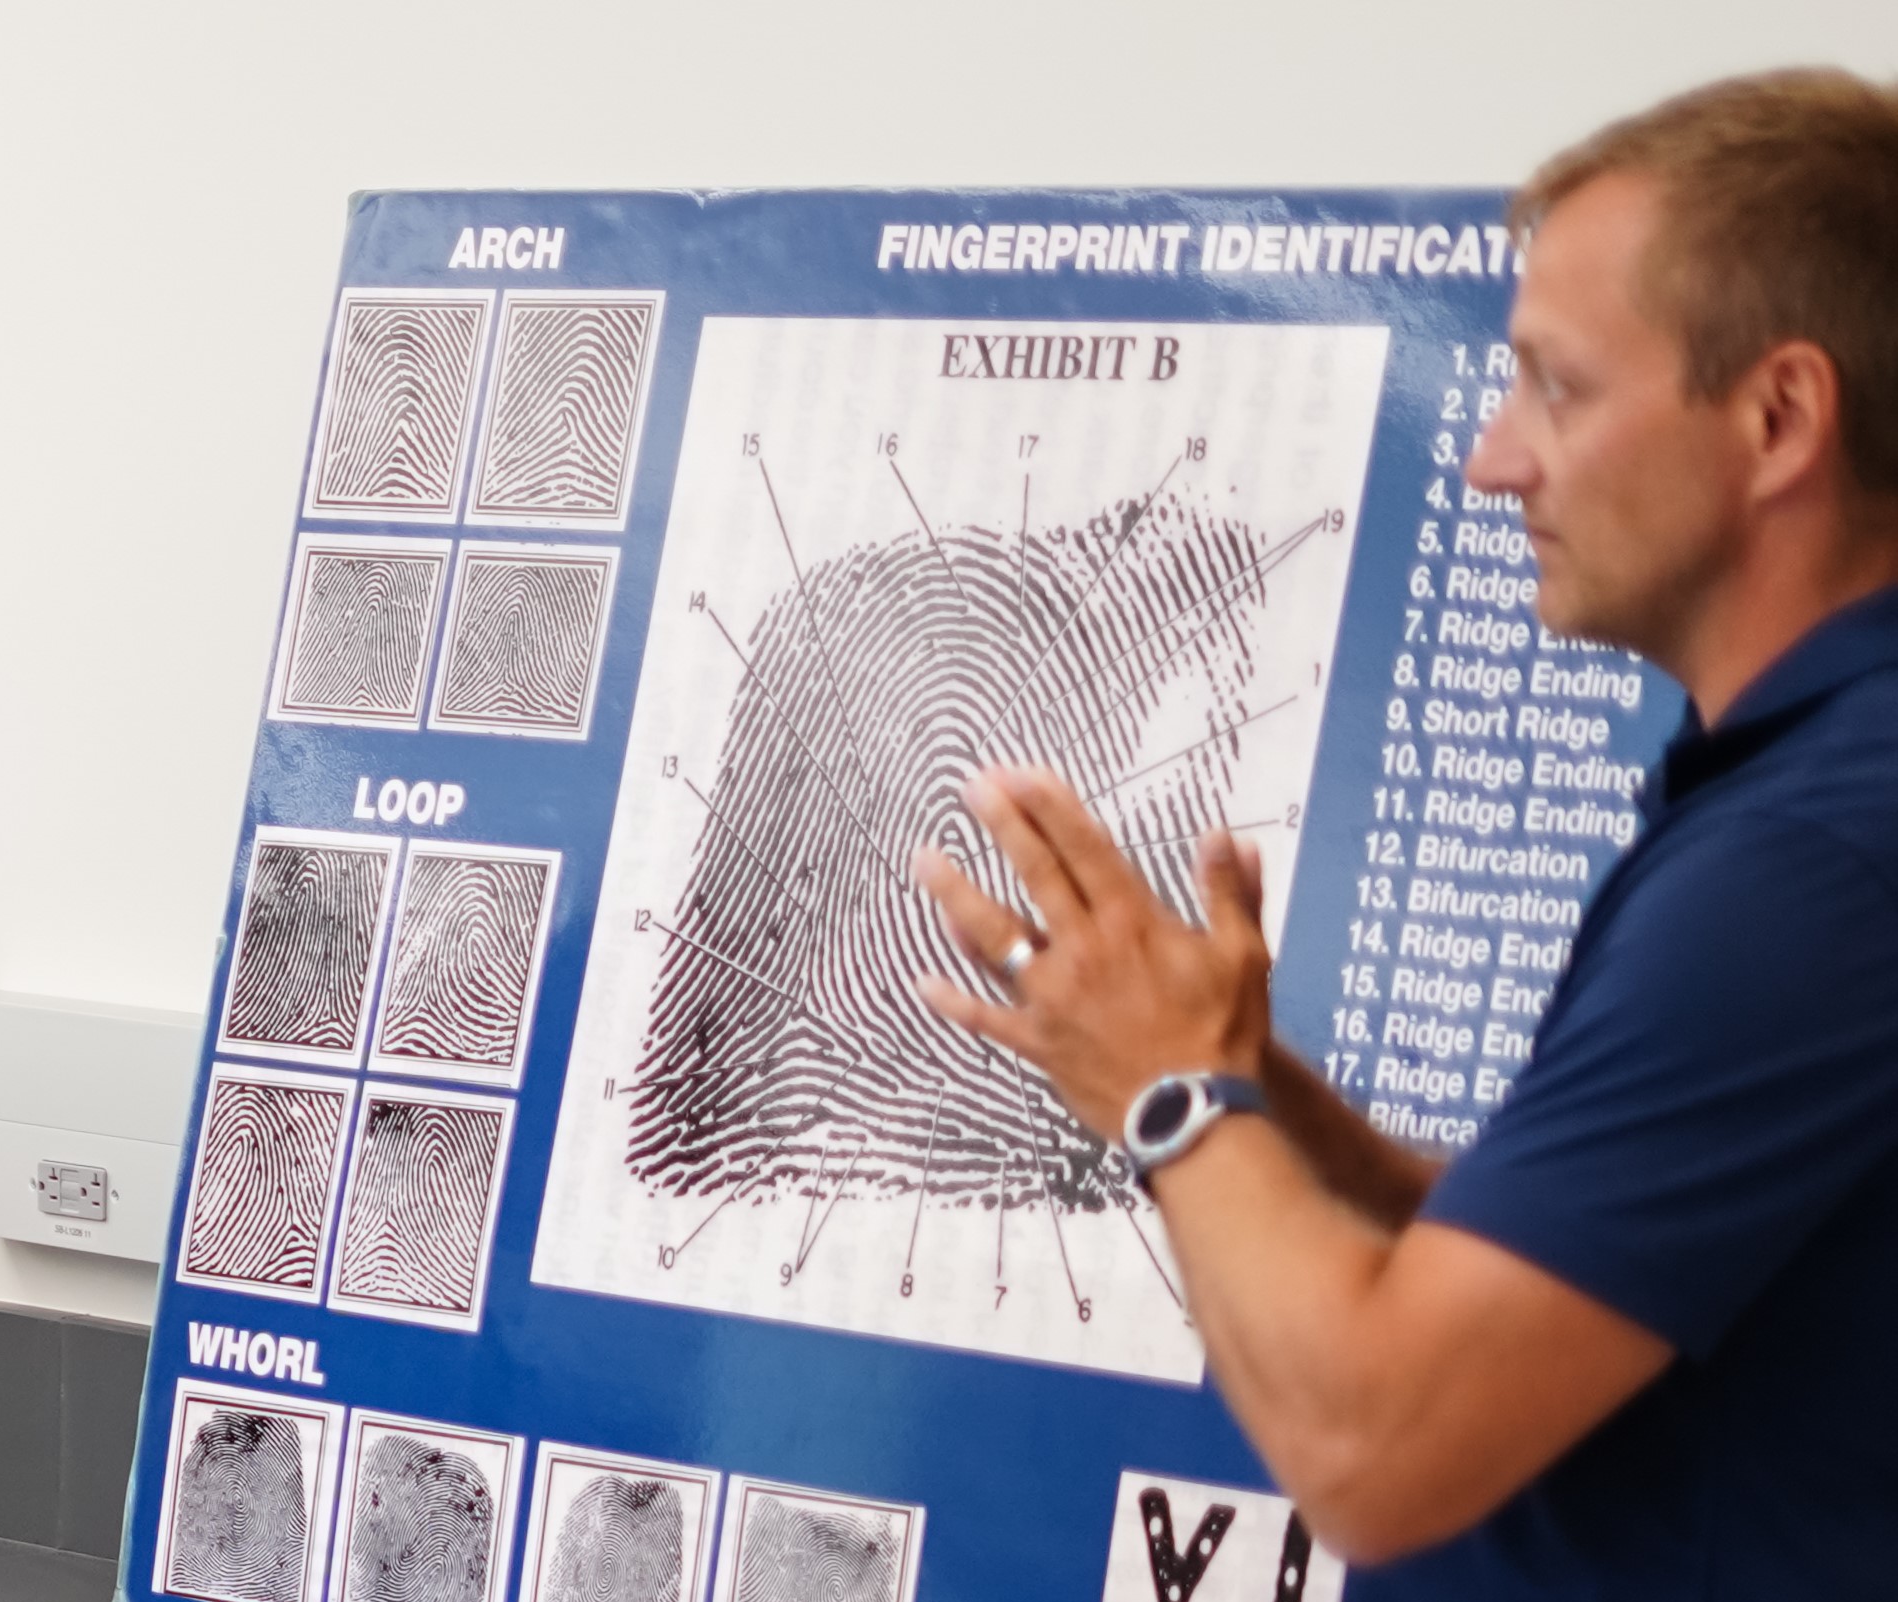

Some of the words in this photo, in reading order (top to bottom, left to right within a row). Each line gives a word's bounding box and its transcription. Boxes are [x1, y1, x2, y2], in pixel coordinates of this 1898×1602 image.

[447, 226, 566, 270] ARCH
[876, 223, 1191, 273] FINGERPRINT
[1199, 224, 1532, 276] IDENTIFICATI
[937, 333, 1136, 381] EXHIBIT
[1147, 335, 1180, 382] B
[1452, 343, 1476, 376] 1.
[1440, 387, 1467, 421] 2.
[741, 432, 761, 457] 15
[877, 432, 900, 458] 16
[1017, 433, 1040, 459] 17
[1184, 436, 1207, 463] 18
[1432, 431, 1459, 466] 3.
[1425, 476, 1452, 509] 4.
[1322, 508, 1345, 534] 19
[1417, 521, 1444, 554] 5.
[688, 590, 707, 614] 14
[1409, 565, 1436, 599] 6.
[1445, 566, 1539, 610] Ridge
[1403, 609, 1429, 644] 7.
[1437, 610, 1530, 653] Ridge
[1392, 653, 1420, 688] 8.
[1429, 655, 1522, 699] Ridge
[1529, 660, 1643, 707] Ending
[1386, 698, 1412, 732] 9.
[1421, 699, 1509, 738] Short
[1515, 706, 1610, 750] Ridge
[661, 755, 679, 779] 13
[1381, 743, 1422, 778] 10.
[1431, 745, 1524, 790] Ridge
[1531, 752, 1645, 799] Ending
[352, 776, 466, 826] LOOP
[1285, 802, 1301, 830] 2
[1373, 786, 1414, 822] 11.
[1423, 789, 1516, 835] Ridge
[1523, 796, 1637, 847] Ending
[1365, 831, 1406, 866] 12.
[1415, 833, 1589, 882] Bifurcation
[1357, 875, 1398, 911] 13.
[1406, 878, 1582, 927] Bifurcation
[633, 909, 652, 934] 12
[1349, 919, 1390, 955] 14.
[1398, 923, 1492, 968] Ridge
[1497, 931, 1573, 972] Endi
[1340, 963, 1381, 999] 15.
[1390, 967, 1483, 1013] Ridge
[1332, 1007, 1374, 1043] 16.
[1382, 1011, 1475, 1058] Ridge
[1324, 1051, 1365, 1087] 17.
[1373, 1056, 1466, 1104] Ridge
[1367, 1101, 1485, 1147] Bifurca
[657, 1245, 676, 1271] 10
[779, 1262, 794, 1287] 9
[900, 1273, 914, 1298] 8
[994, 1285, 1008, 1311] 7
[1076, 1297, 1092, 1323] 6
[187, 1320, 325, 1385] WHORL
